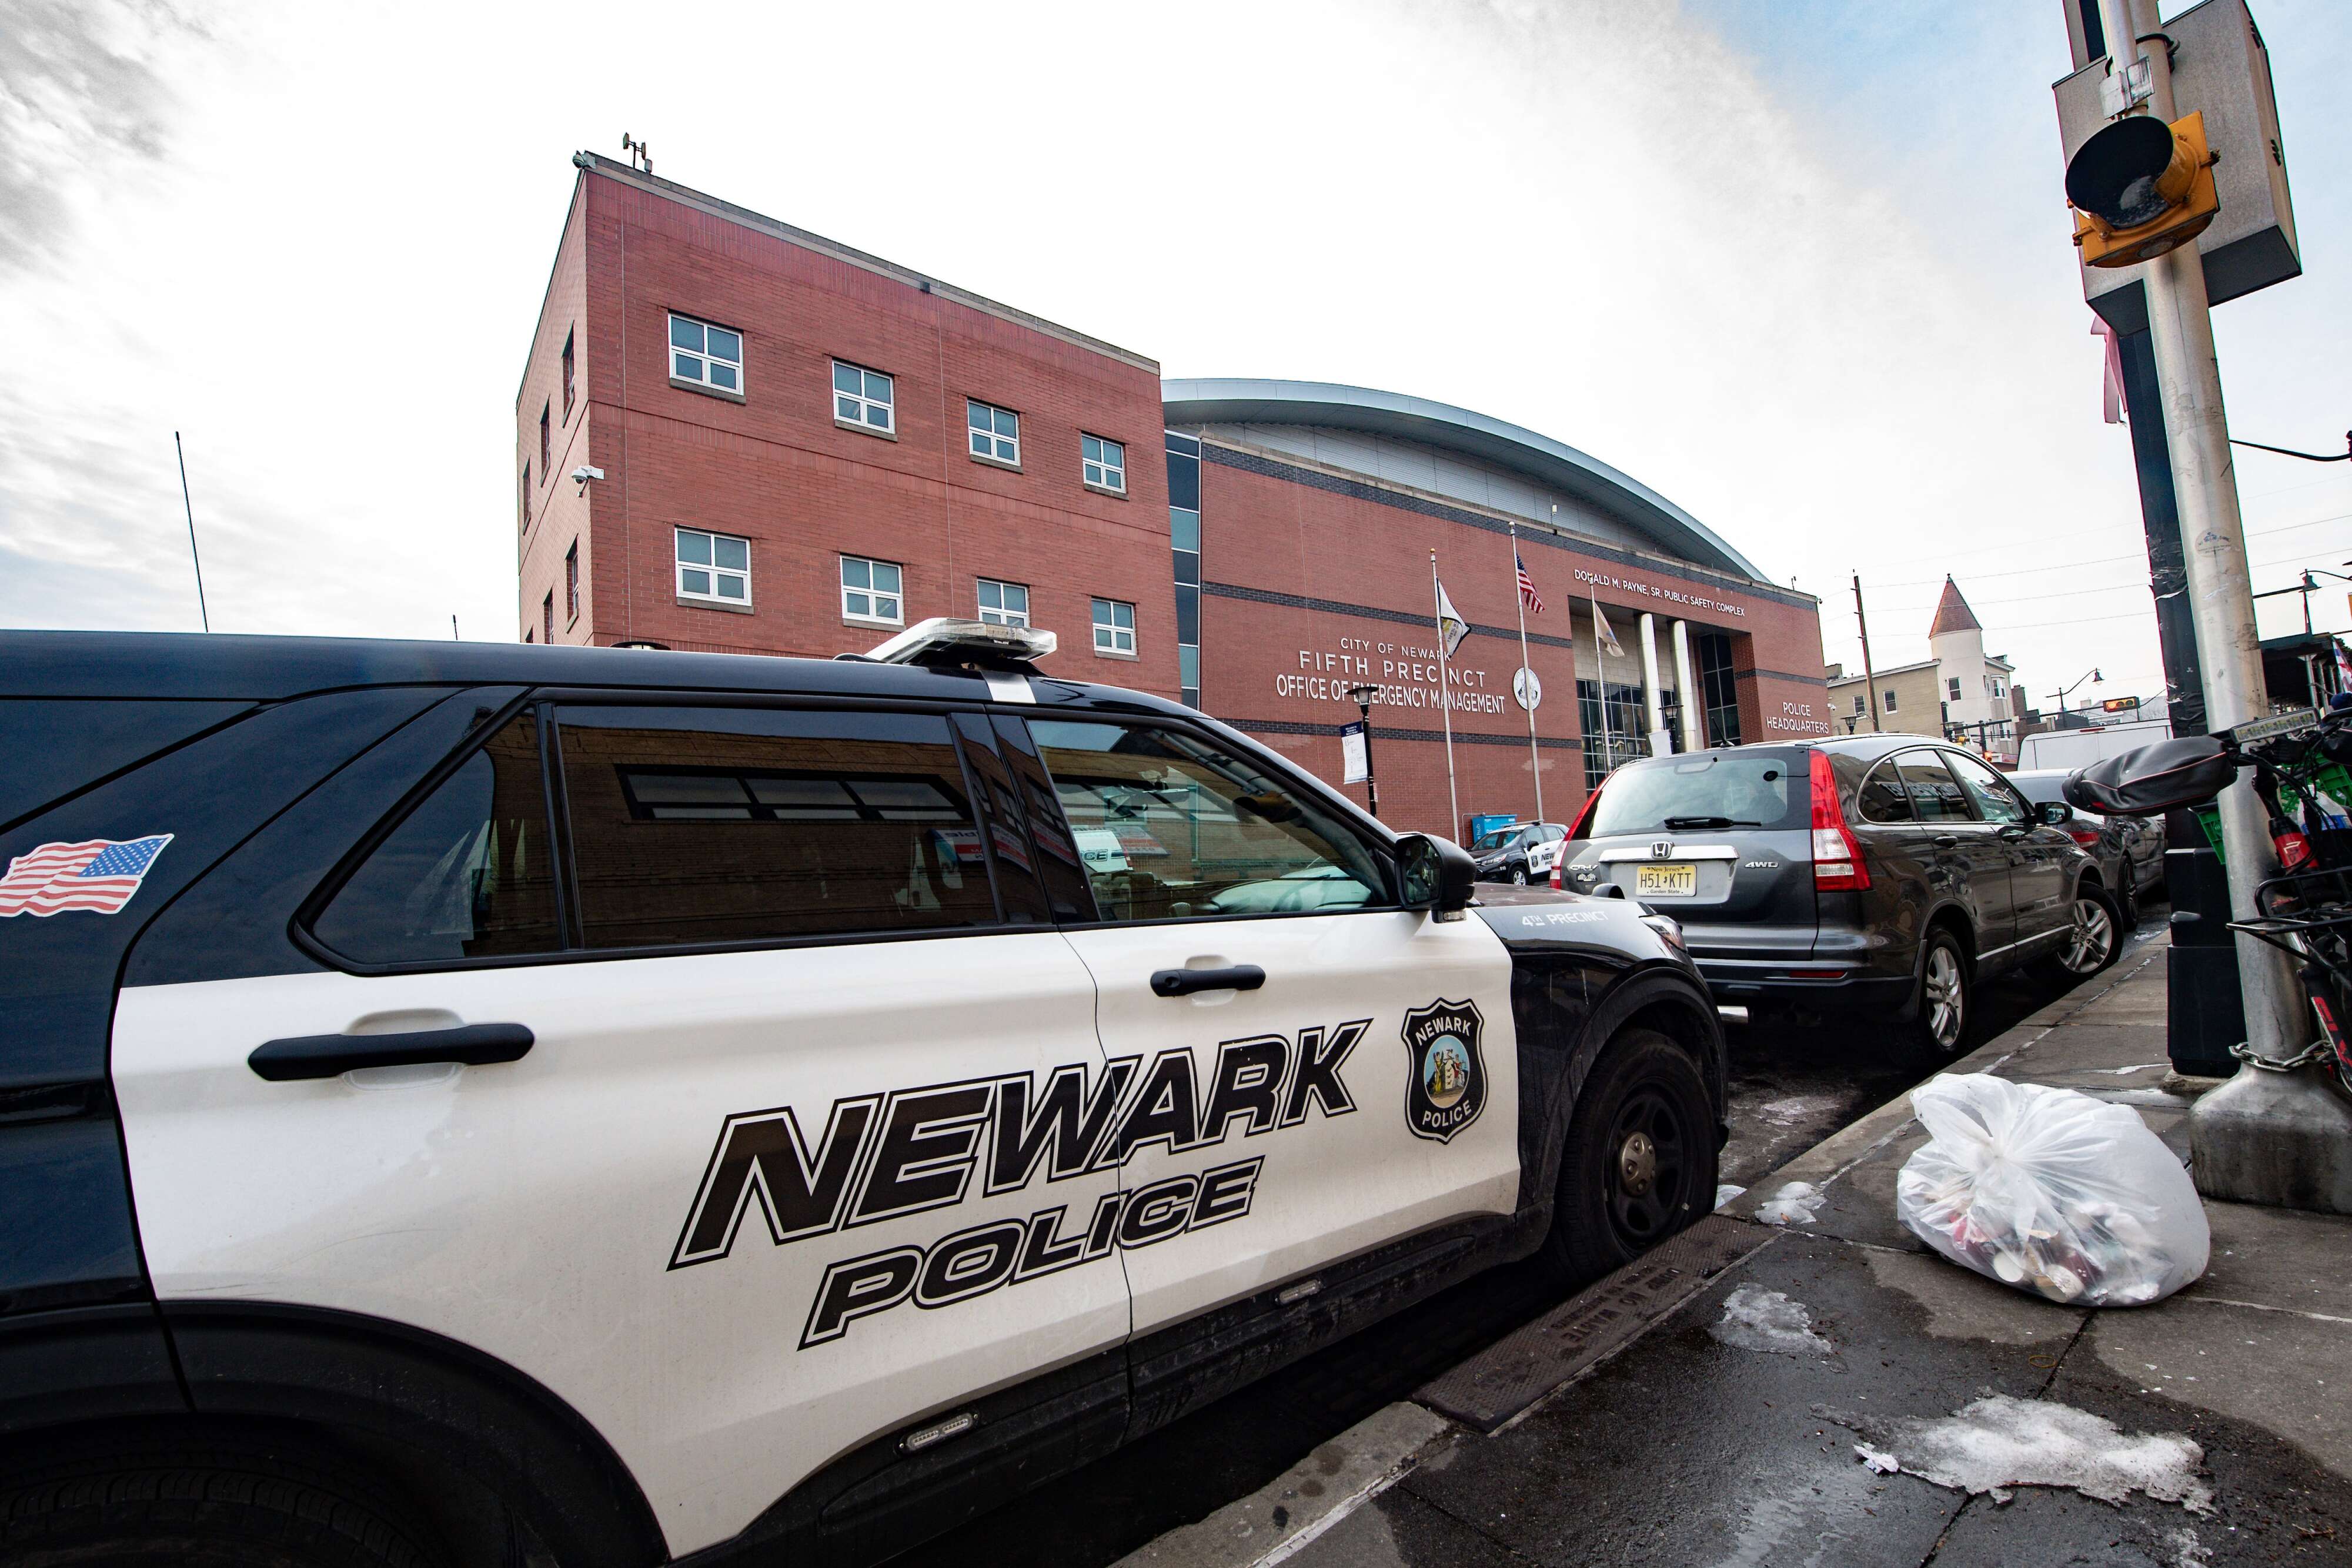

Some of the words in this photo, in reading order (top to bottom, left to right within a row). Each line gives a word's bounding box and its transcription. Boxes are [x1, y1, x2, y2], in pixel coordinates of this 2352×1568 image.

[1612, 577, 1621, 589] M.
[1623, 580, 1649, 597] PAYNE,
[1651, 586, 1662, 598] SR.
[1665, 590, 1688, 604] PUBLIC
[1690, 596, 1714, 610] SAFETY
[1716, 602, 1745, 617] COMPLEX
[1341, 637, 1369, 651] CITY
[1378, 643, 1394, 654] OF
[1299, 650, 1368, 676] FIFTH
[1383, 660, 1485, 687] PRECNCT
[1277, 674, 1327, 700] OFFICE
[1331, 679, 1349, 701] OF
[1783, 701, 1811, 717] POLICE
[1766, 716, 1829, 734] HEADQUARTERS
[1641, 873, 1661, 888] H51
[1669, 872, 1691, 888] KTT
[1522, 915, 1545, 927] 4TH
[1546, 911, 1609, 925] PRECINCT
[1415, 1016, 1471, 1046] NEWARK
[1422, 1099, 1472, 1128] POLICE
[667, 1018, 1374, 1271] NEWARK
[797, 1155, 1265, 1351] POLICE
[1561, 1309, 1622, 1342] WASTE
